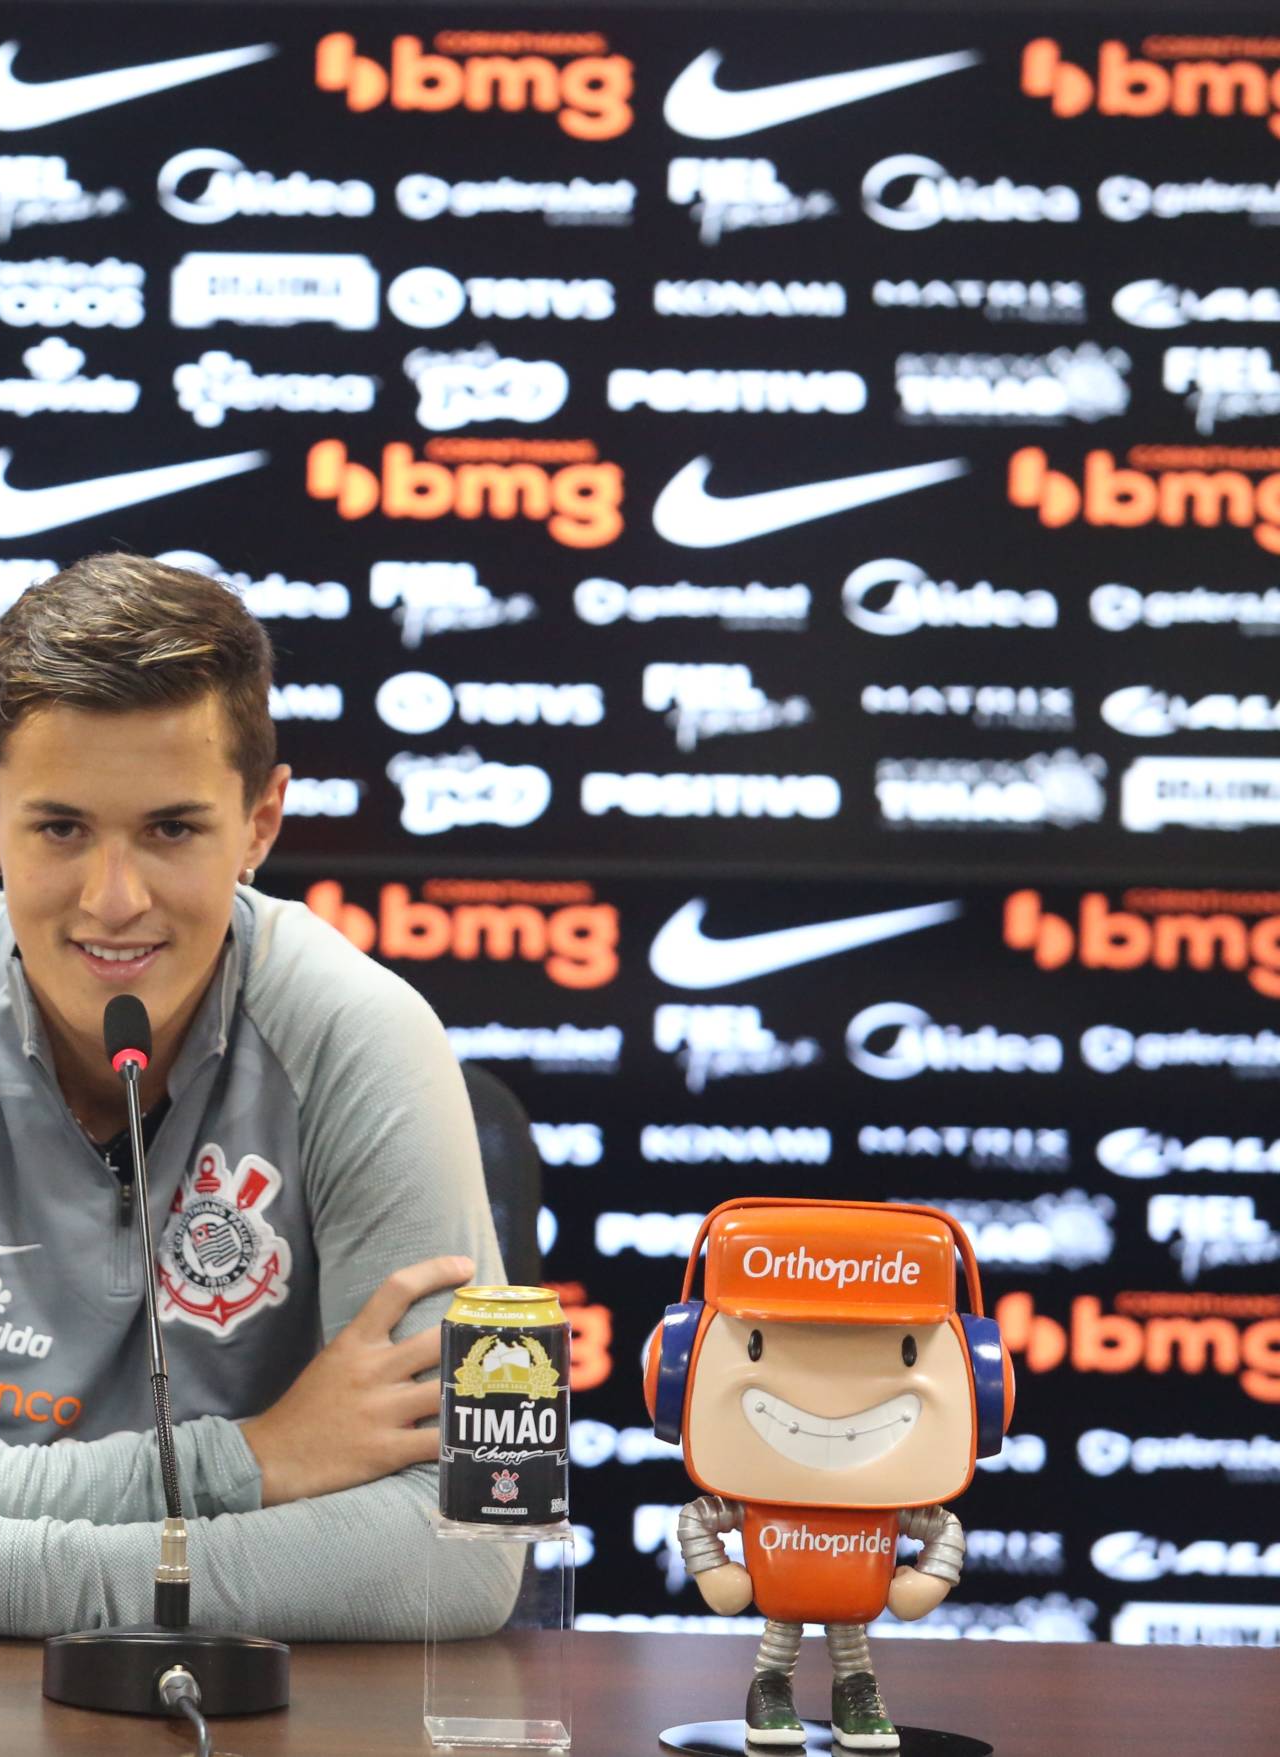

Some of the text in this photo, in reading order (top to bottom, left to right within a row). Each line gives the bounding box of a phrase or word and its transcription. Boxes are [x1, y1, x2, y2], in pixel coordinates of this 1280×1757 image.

[390, 34, 636, 141] bmg
[1097, 39, 1280, 140] bm
[381, 441, 625, 549] bmg
[379, 883, 620, 989] bmg
[742, 1244, 921, 1288] Orthopride
[454, 1400, 558, 1445] TIMÃO
[474, 1445, 544, 1463] Chopp
[759, 1523, 892, 1557] Orthopride
